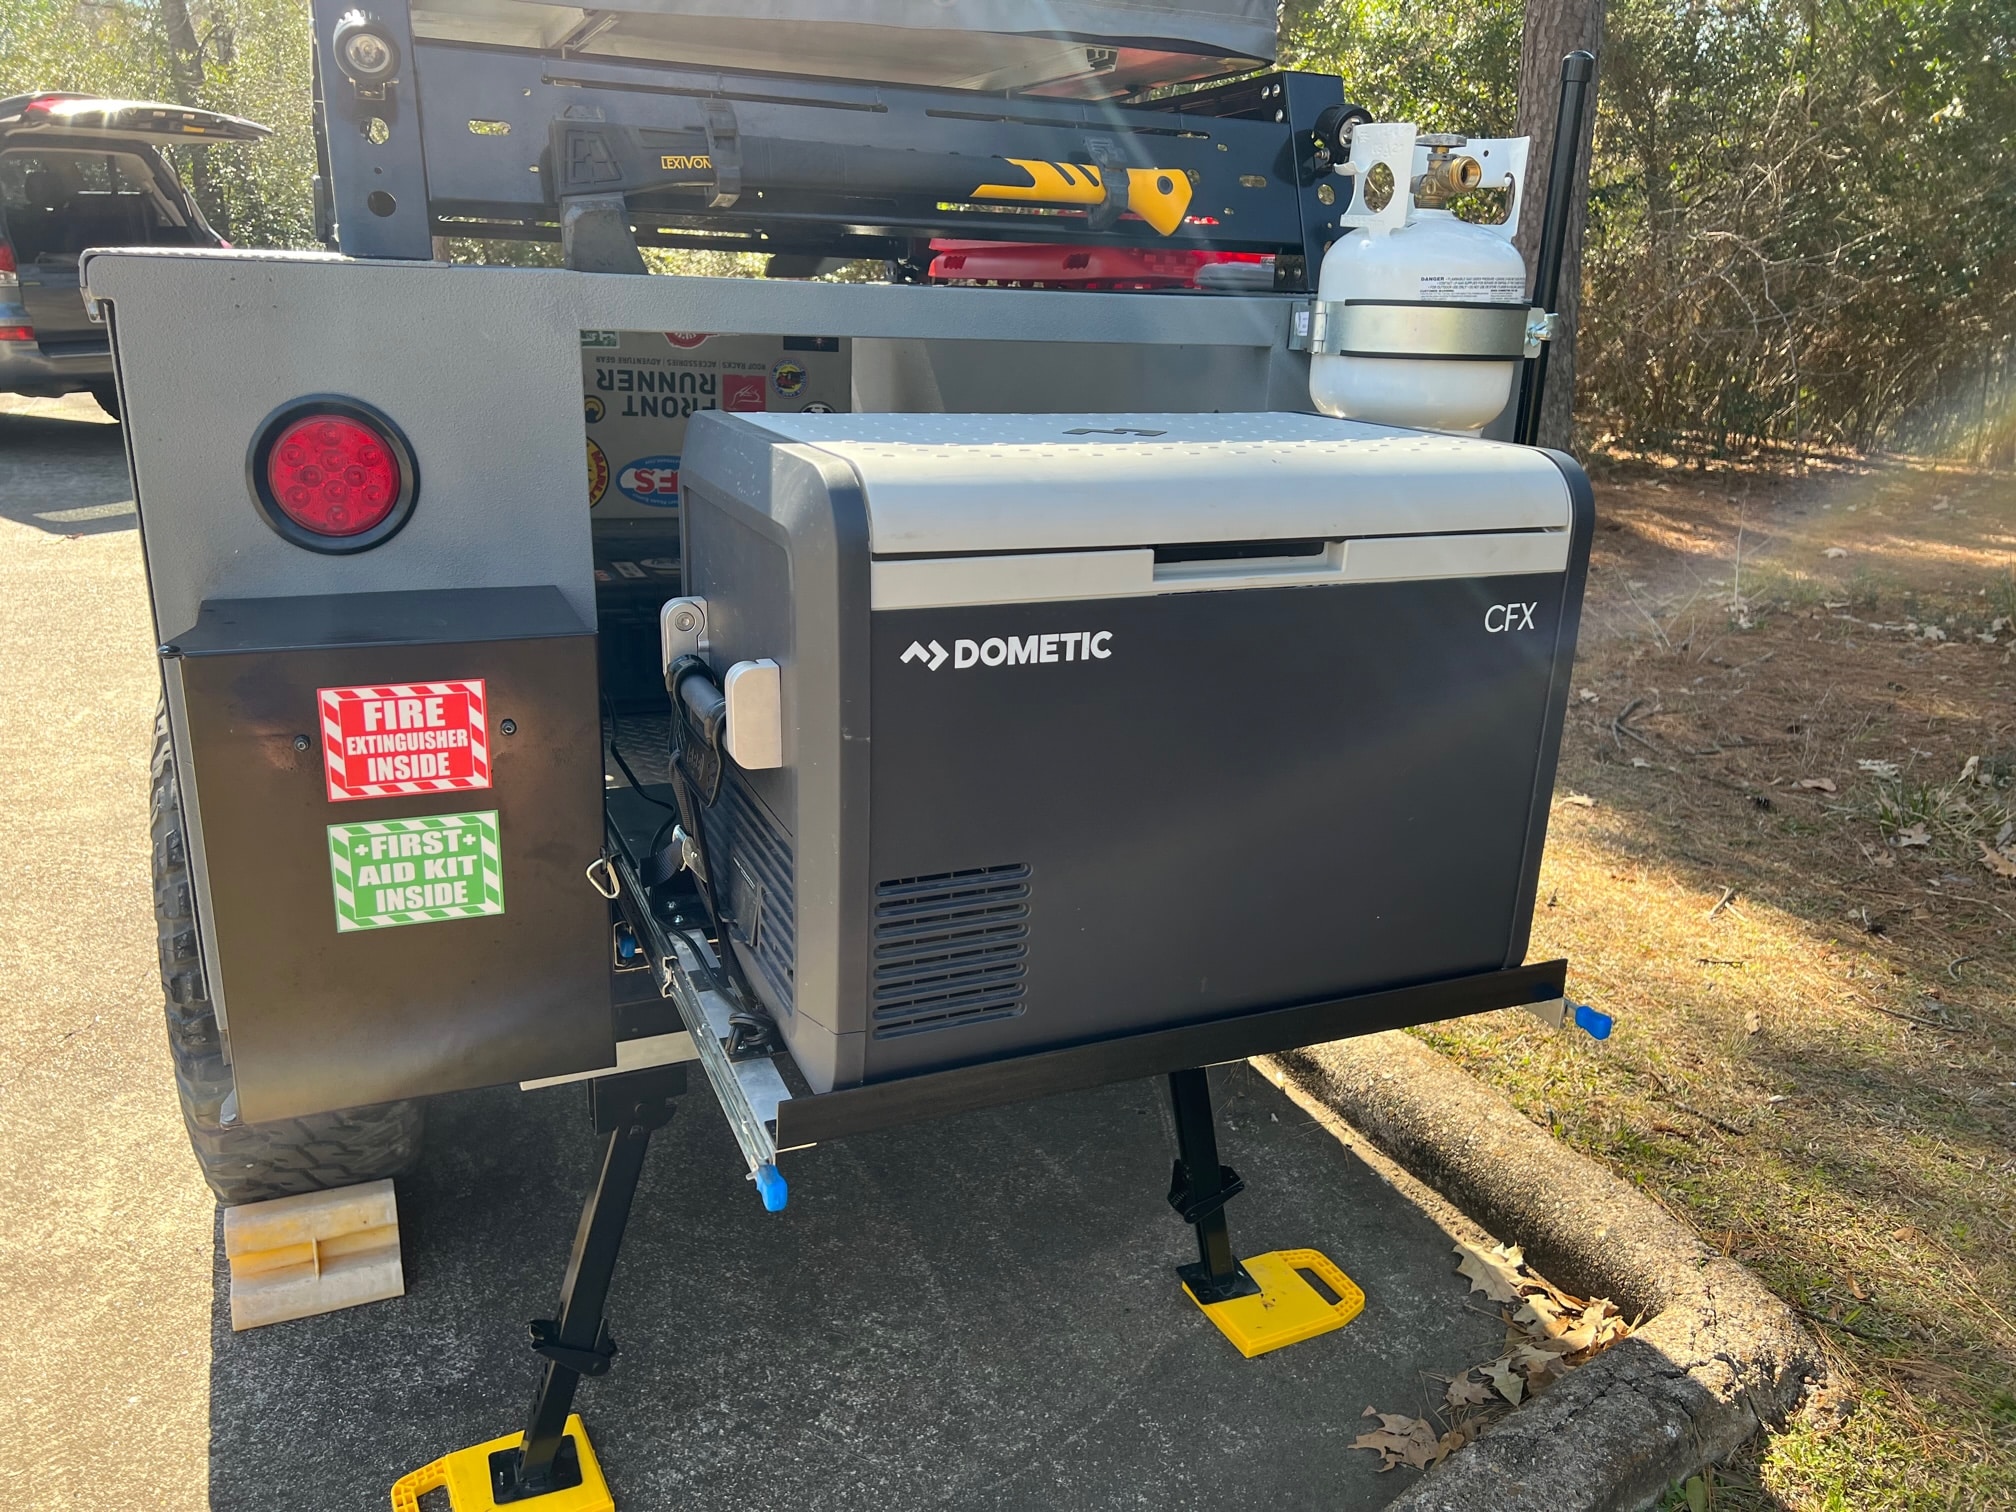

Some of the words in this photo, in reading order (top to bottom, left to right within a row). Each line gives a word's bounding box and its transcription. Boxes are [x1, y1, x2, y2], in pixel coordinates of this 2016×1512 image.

[660, 155, 713, 170] LEXIVON
[595, 355, 616, 364] GEAR
[617, 356, 661, 366] ADVENTURE
[667, 359, 717, 368] ACCESSORIES
[722, 361, 746, 370] RACKS
[748, 362, 766, 370] ROOF
[596, 369, 716, 395] RUNNER
[1484, 601, 1538, 633] CFX
[953, 630, 1114, 669] DOMETIC
[362, 697, 446, 732] FIRE
[346, 728, 468, 756] EXTINGUISHER
[367, 752, 451, 782] INSIDE
[370, 829, 462, 860] FIRST
[358, 861, 416, 887] AID
[424, 855, 478, 880] KIT
[376, 881, 469, 913] INSIDE
